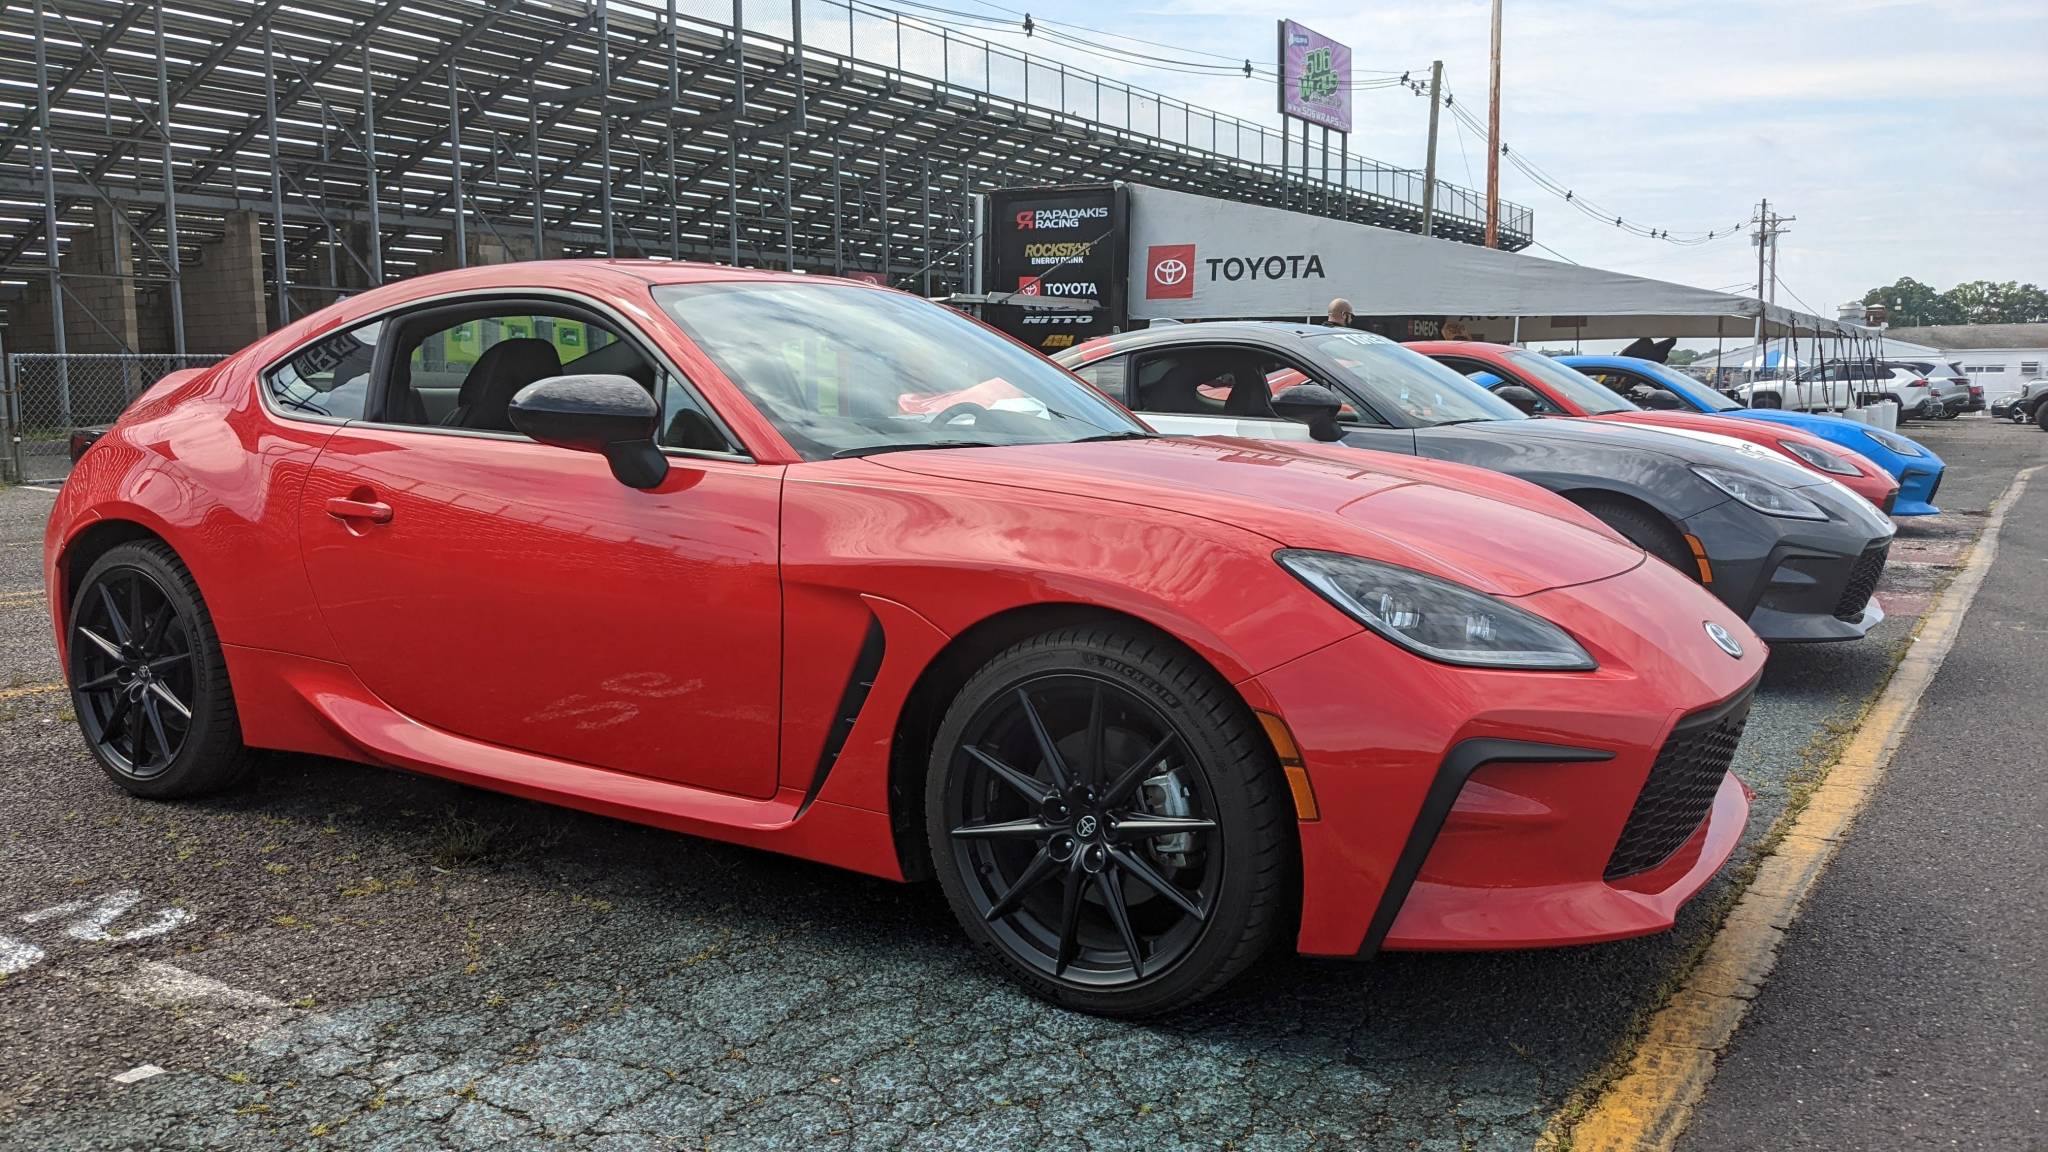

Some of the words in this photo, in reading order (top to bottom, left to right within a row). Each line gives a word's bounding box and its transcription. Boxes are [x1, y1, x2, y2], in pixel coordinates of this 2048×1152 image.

[1035, 207, 1108, 220] PAPADAKIS
[1035, 218, 1079, 229] RACING
[1025, 242, 1091, 258] ROCKSTAR
[1031, 257, 1060, 265] ENERGY
[1206, 254, 1325, 282] TOYOTA
[1045, 282, 1098, 296] TOYOTA
[1022, 315, 1093, 324] NITTO
[1413, 319, 1439, 337] ENEOS
[1102, 658, 1177, 706] MICHELIN
